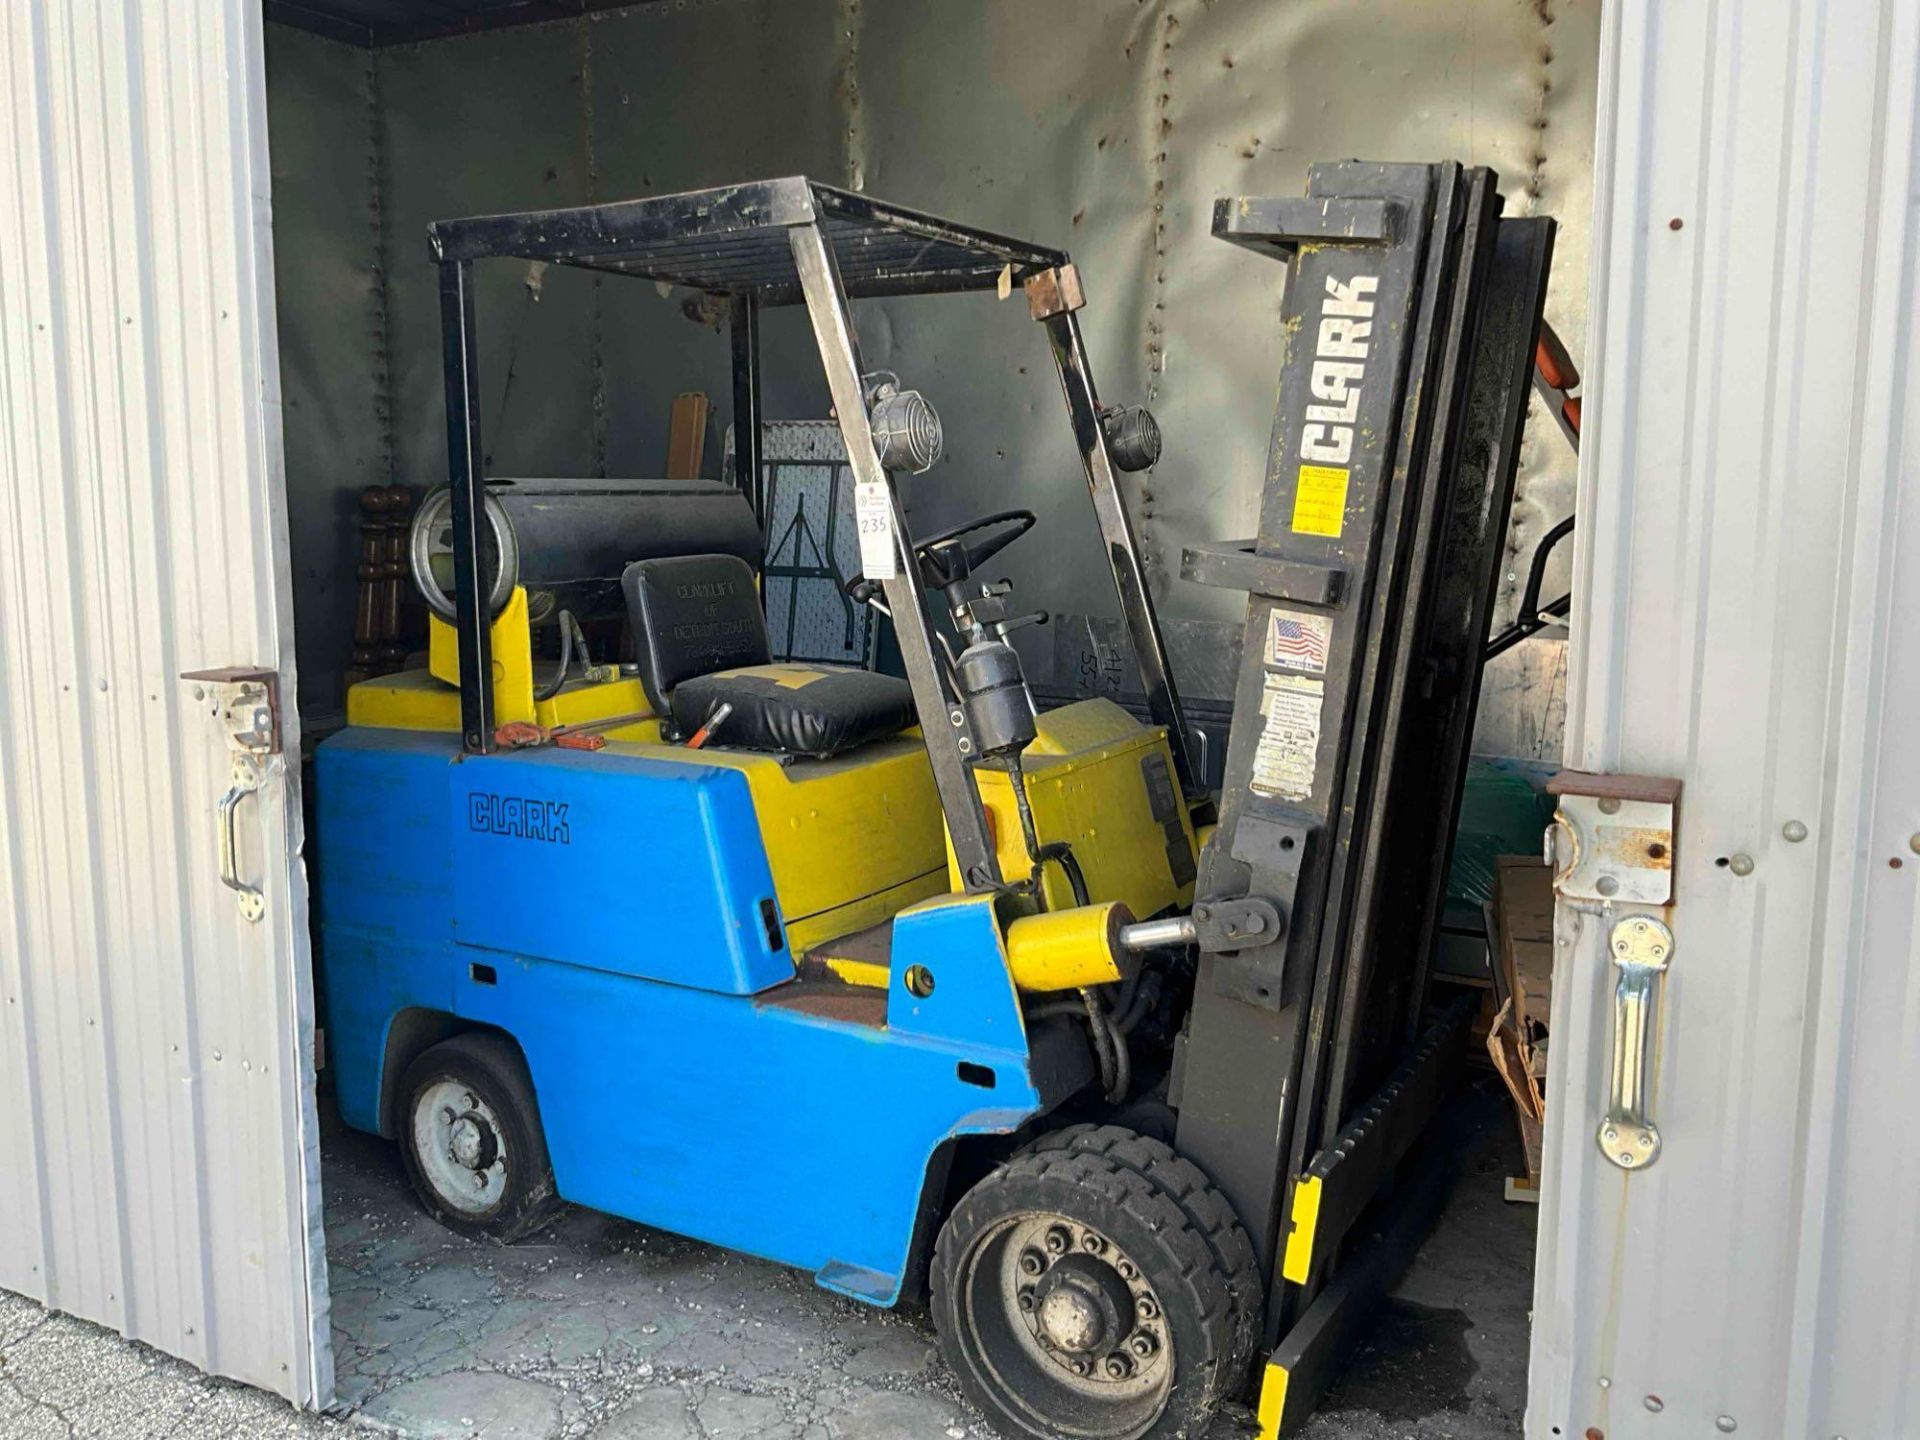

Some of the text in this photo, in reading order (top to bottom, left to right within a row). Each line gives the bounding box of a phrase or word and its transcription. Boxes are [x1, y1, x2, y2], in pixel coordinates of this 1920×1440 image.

[1300, 275, 1379, 464] CLARK
[861, 516, 886, 534] 235
[468, 792, 570, 844] CLARK
